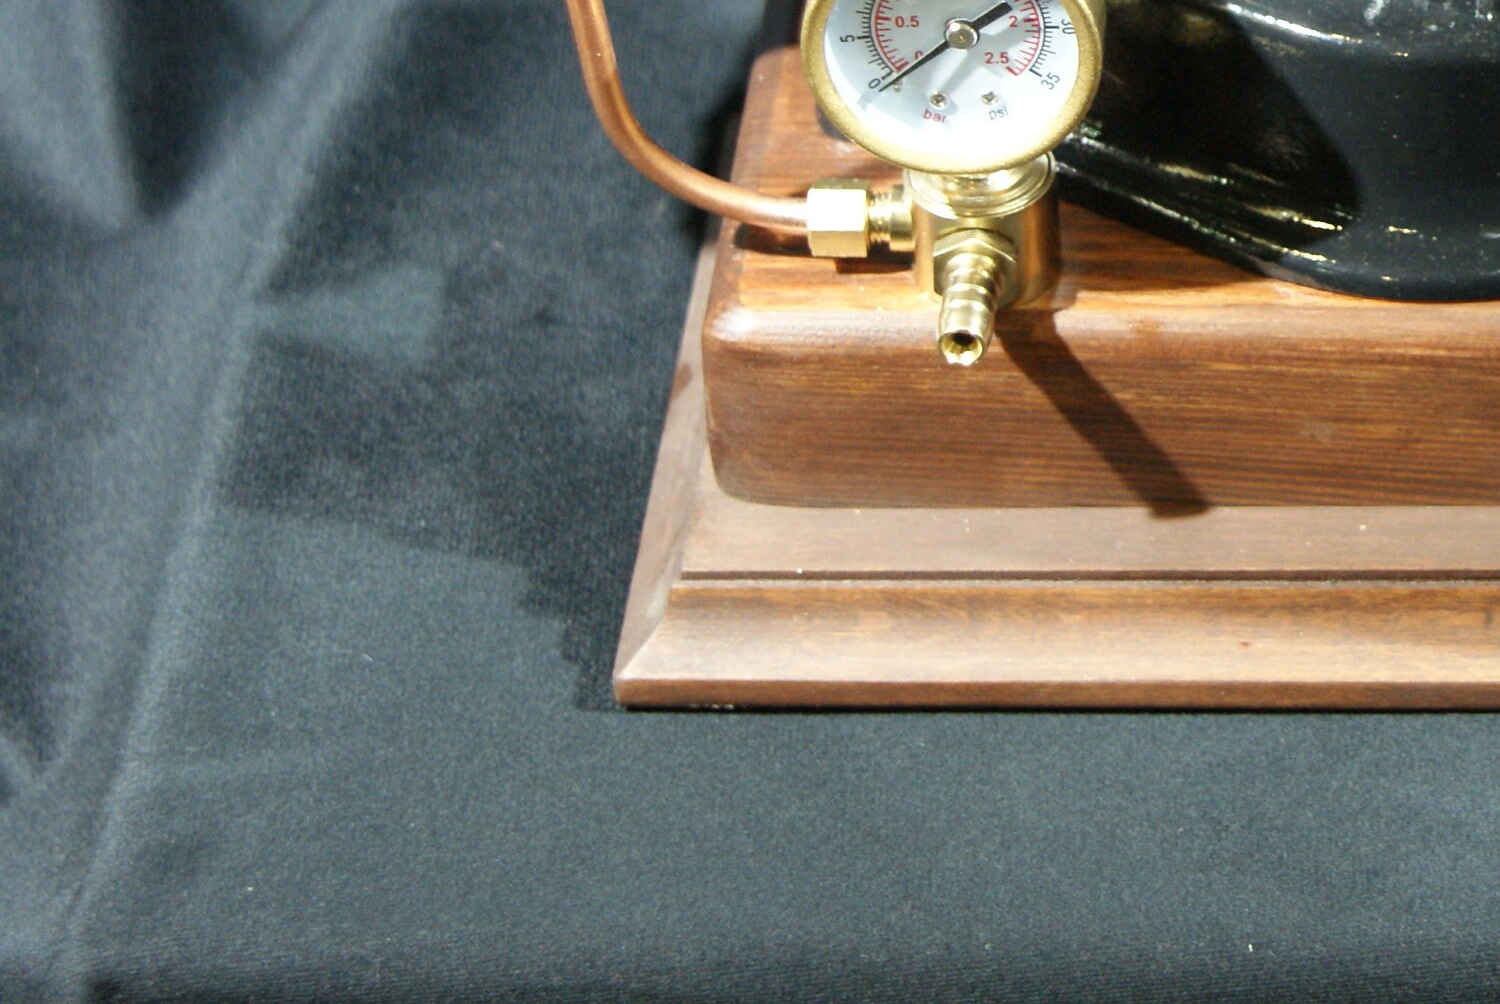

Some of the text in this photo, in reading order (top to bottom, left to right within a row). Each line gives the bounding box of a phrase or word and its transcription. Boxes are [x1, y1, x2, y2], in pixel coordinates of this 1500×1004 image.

[895, 15, 920, 28] 0.5
[1008, 15, 1018, 28] 2
[840, 34, 856, 43] 5
[985, 52, 1009, 64] 2.5
[868, 78, 881, 89] 0
[1041, 72, 1061, 90] 35
[923, 109, 946, 123] bar
[988, 107, 1009, 121] psi
